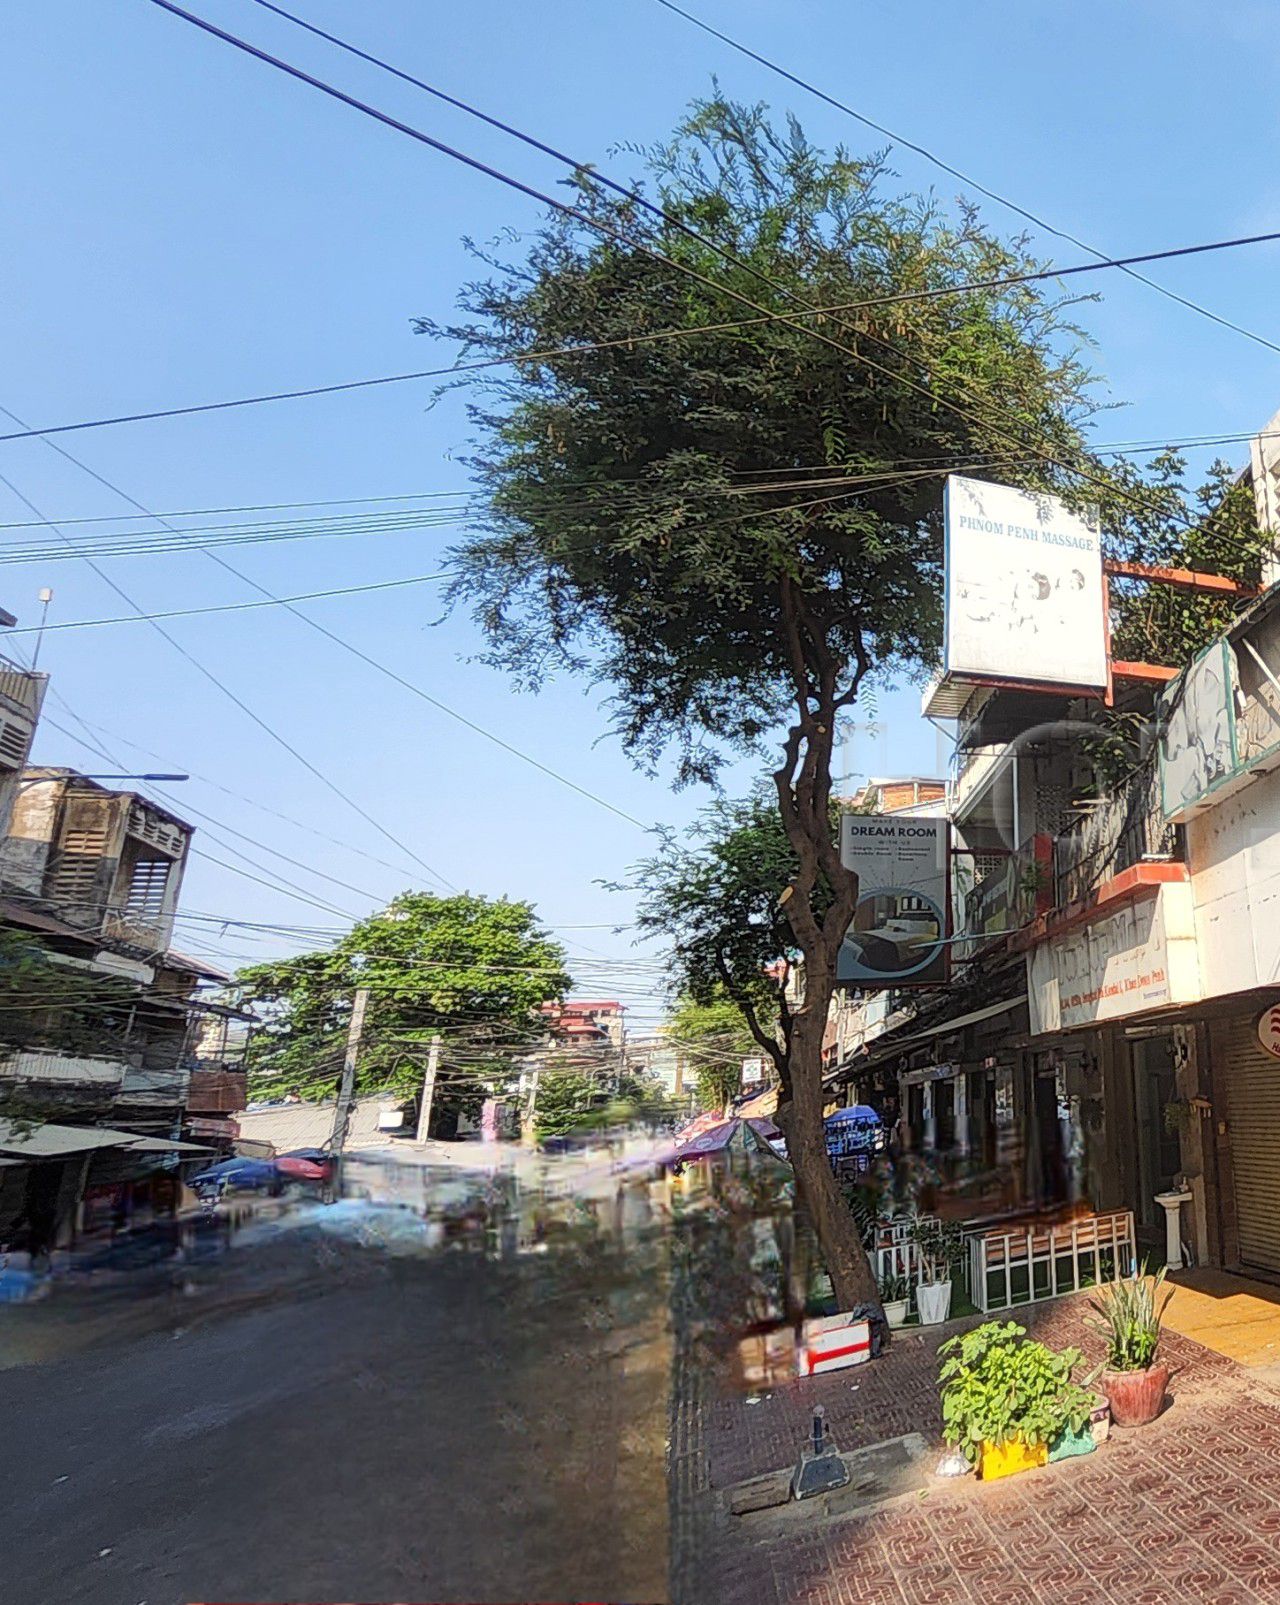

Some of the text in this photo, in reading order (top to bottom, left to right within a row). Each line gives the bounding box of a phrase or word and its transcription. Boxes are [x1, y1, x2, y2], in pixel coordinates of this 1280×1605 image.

[959, 515, 1094, 551] PHNOM PENH MASSAGE
[851, 826, 937, 838] DREAM ROOM
